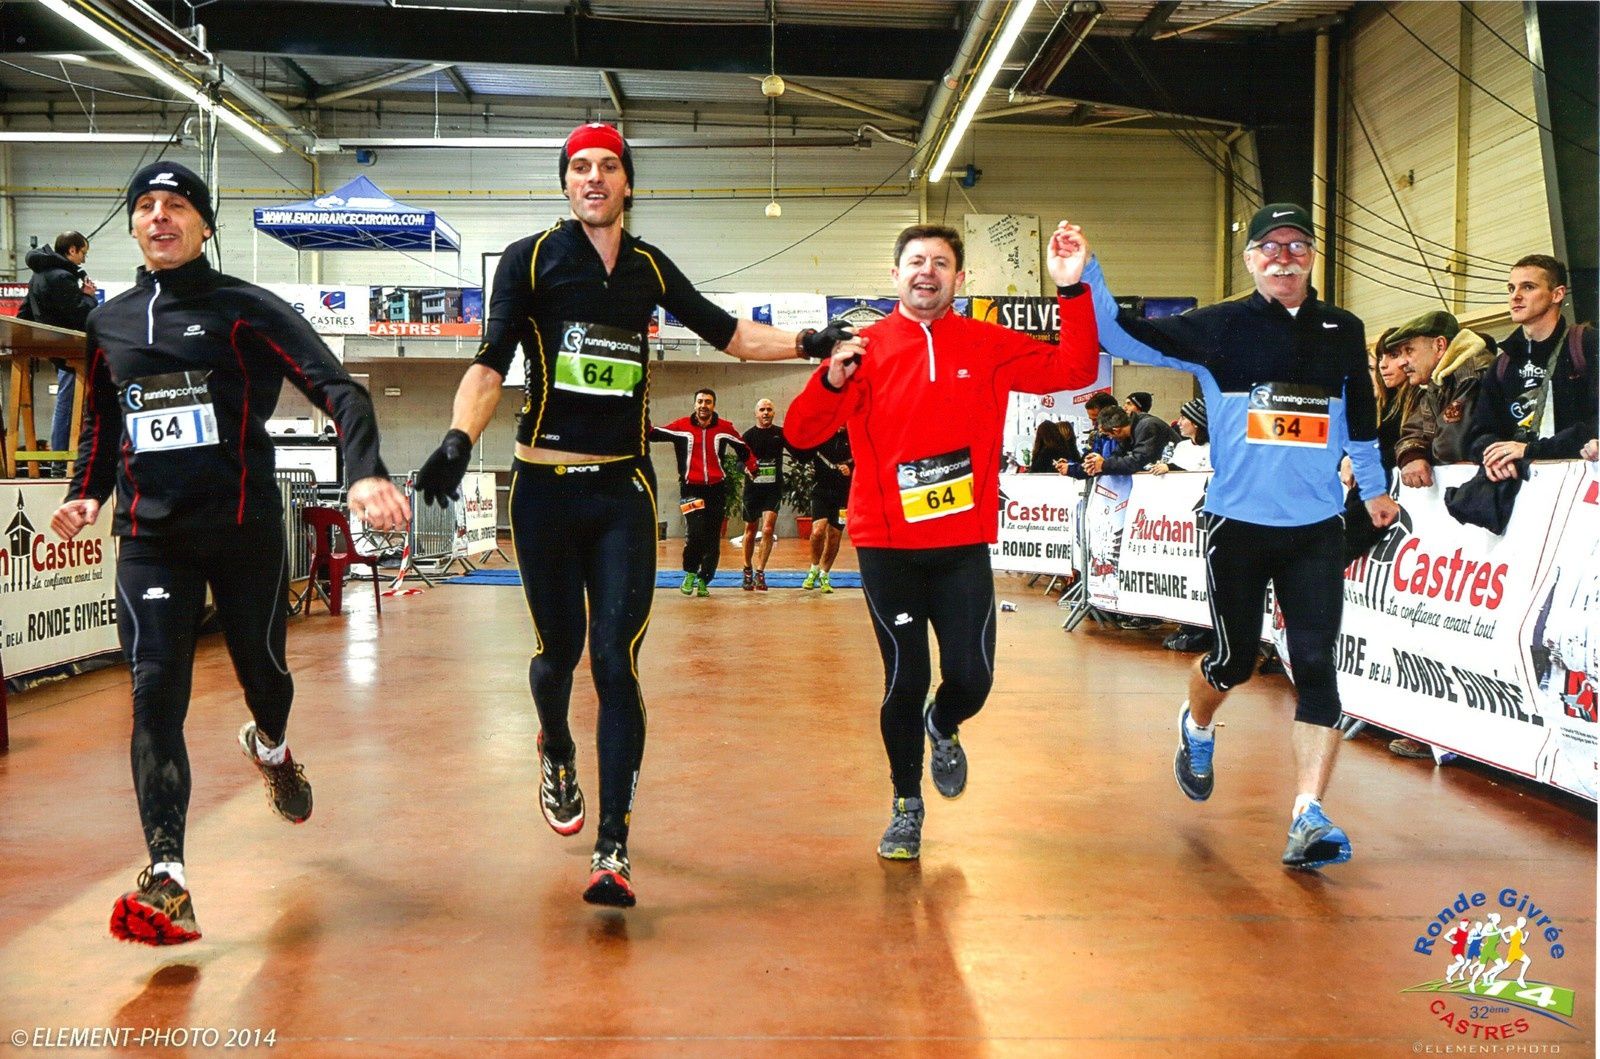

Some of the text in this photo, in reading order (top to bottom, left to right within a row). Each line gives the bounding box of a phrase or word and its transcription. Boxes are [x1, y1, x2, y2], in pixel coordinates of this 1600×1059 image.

[262, 211, 426, 226] WWW.ENDURANCECHRONO.COM
[310, 315, 355, 326] CASTRES
[369, 323, 442, 335] CASTRES
[583, 363, 614, 386] 64
[1272, 395, 1329, 406] runningconseil
[150, 416, 183, 442] 64
[1273, 417, 1301, 438] 64
[926, 486, 955, 509] 64
[1006, 500, 1069, 522] Castres
[1129, 508, 1194, 544] Auchan
[32, 534, 103, 573] Castres
[1002, 541, 1042, 558] RONDE
[1128, 541, 1146, 556] Pays
[31, 575, 42, 589] La
[44, 573, 73, 591] confiance
[1393, 537, 1509, 610] Castres
[1119, 569, 1188, 600] PARTENAIRE
[1191, 590, 1199, 601] DE
[1200, 591, 1207, 602] LA
[6, 633, 15, 647] DE
[15, 632, 23, 646] LA
[28, 606, 71, 643] RONDE
[74, 593, 118, 632] GIVRÉE
[1386, 596, 1398, 617] La
[1401, 601, 1441, 628] confiance
[1443, 614, 1473, 635] avant
[1474, 619, 1497, 640] tout
[1369, 662, 1379, 681] DE
[1381, 664, 1392, 685] LA
[1392, 647, 1458, 703] RONDE
